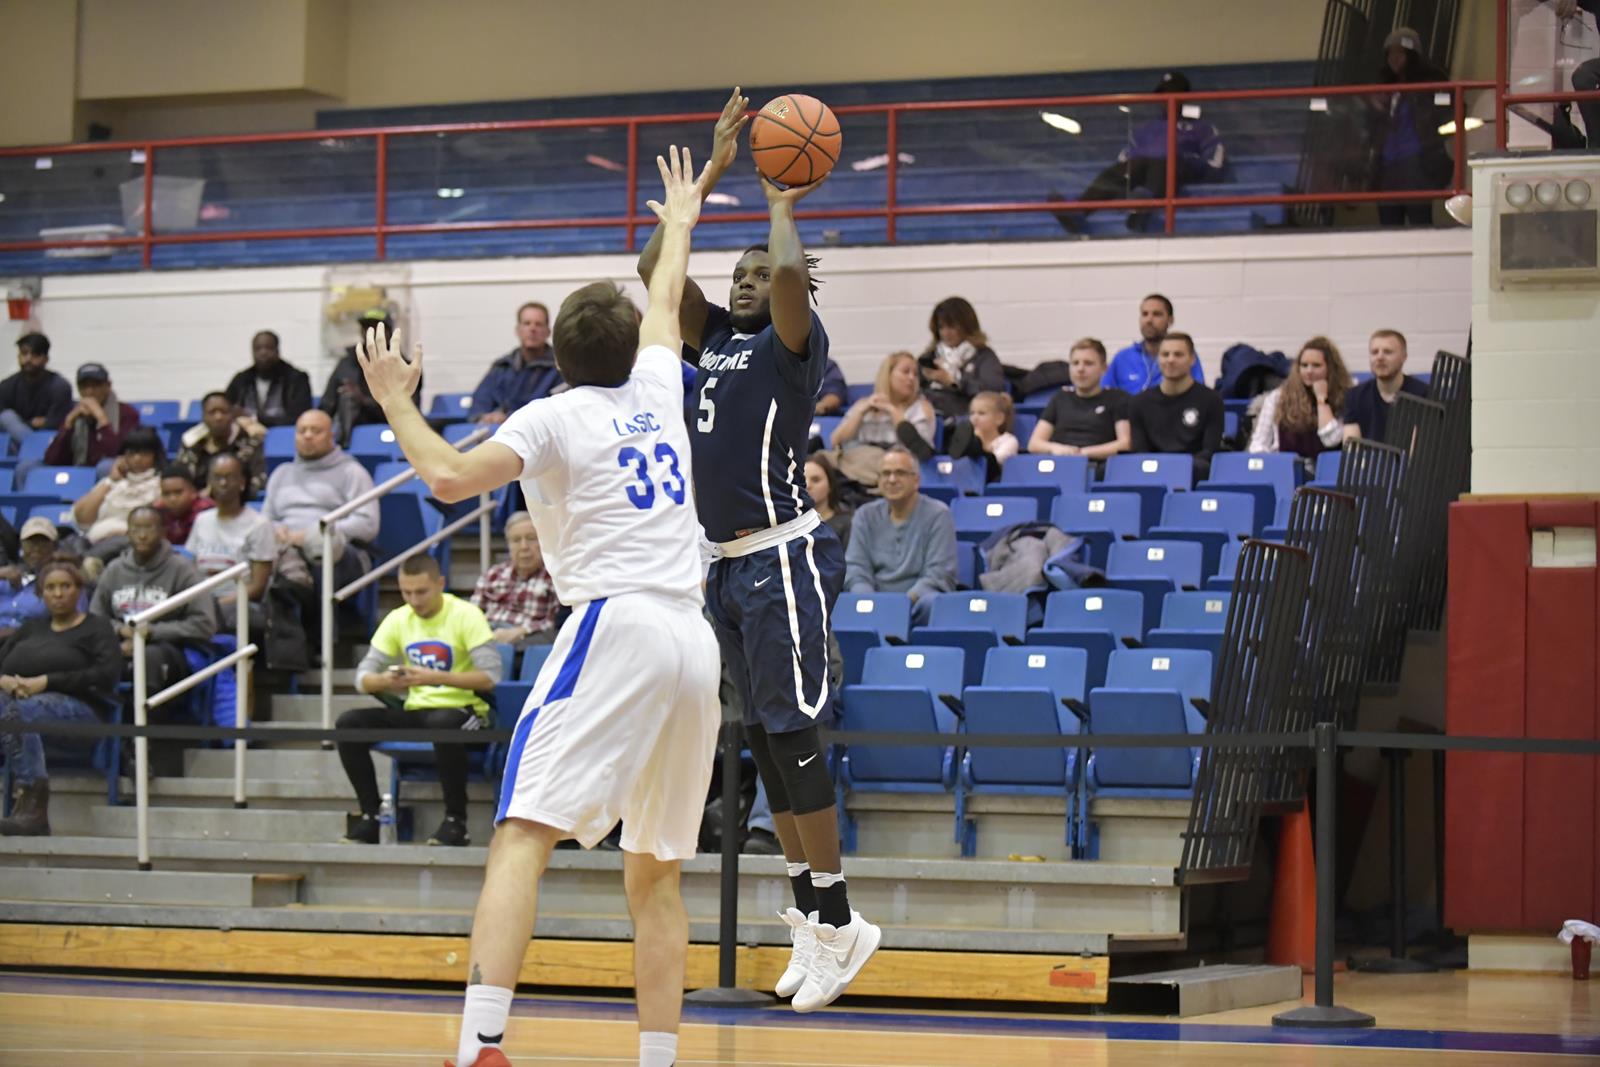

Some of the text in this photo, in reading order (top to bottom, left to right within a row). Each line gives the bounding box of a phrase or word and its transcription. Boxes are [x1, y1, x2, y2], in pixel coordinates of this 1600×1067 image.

[612, 412, 661, 436] LASC
[697, 377, 719, 433] 5
[617, 443, 685, 510] 33
